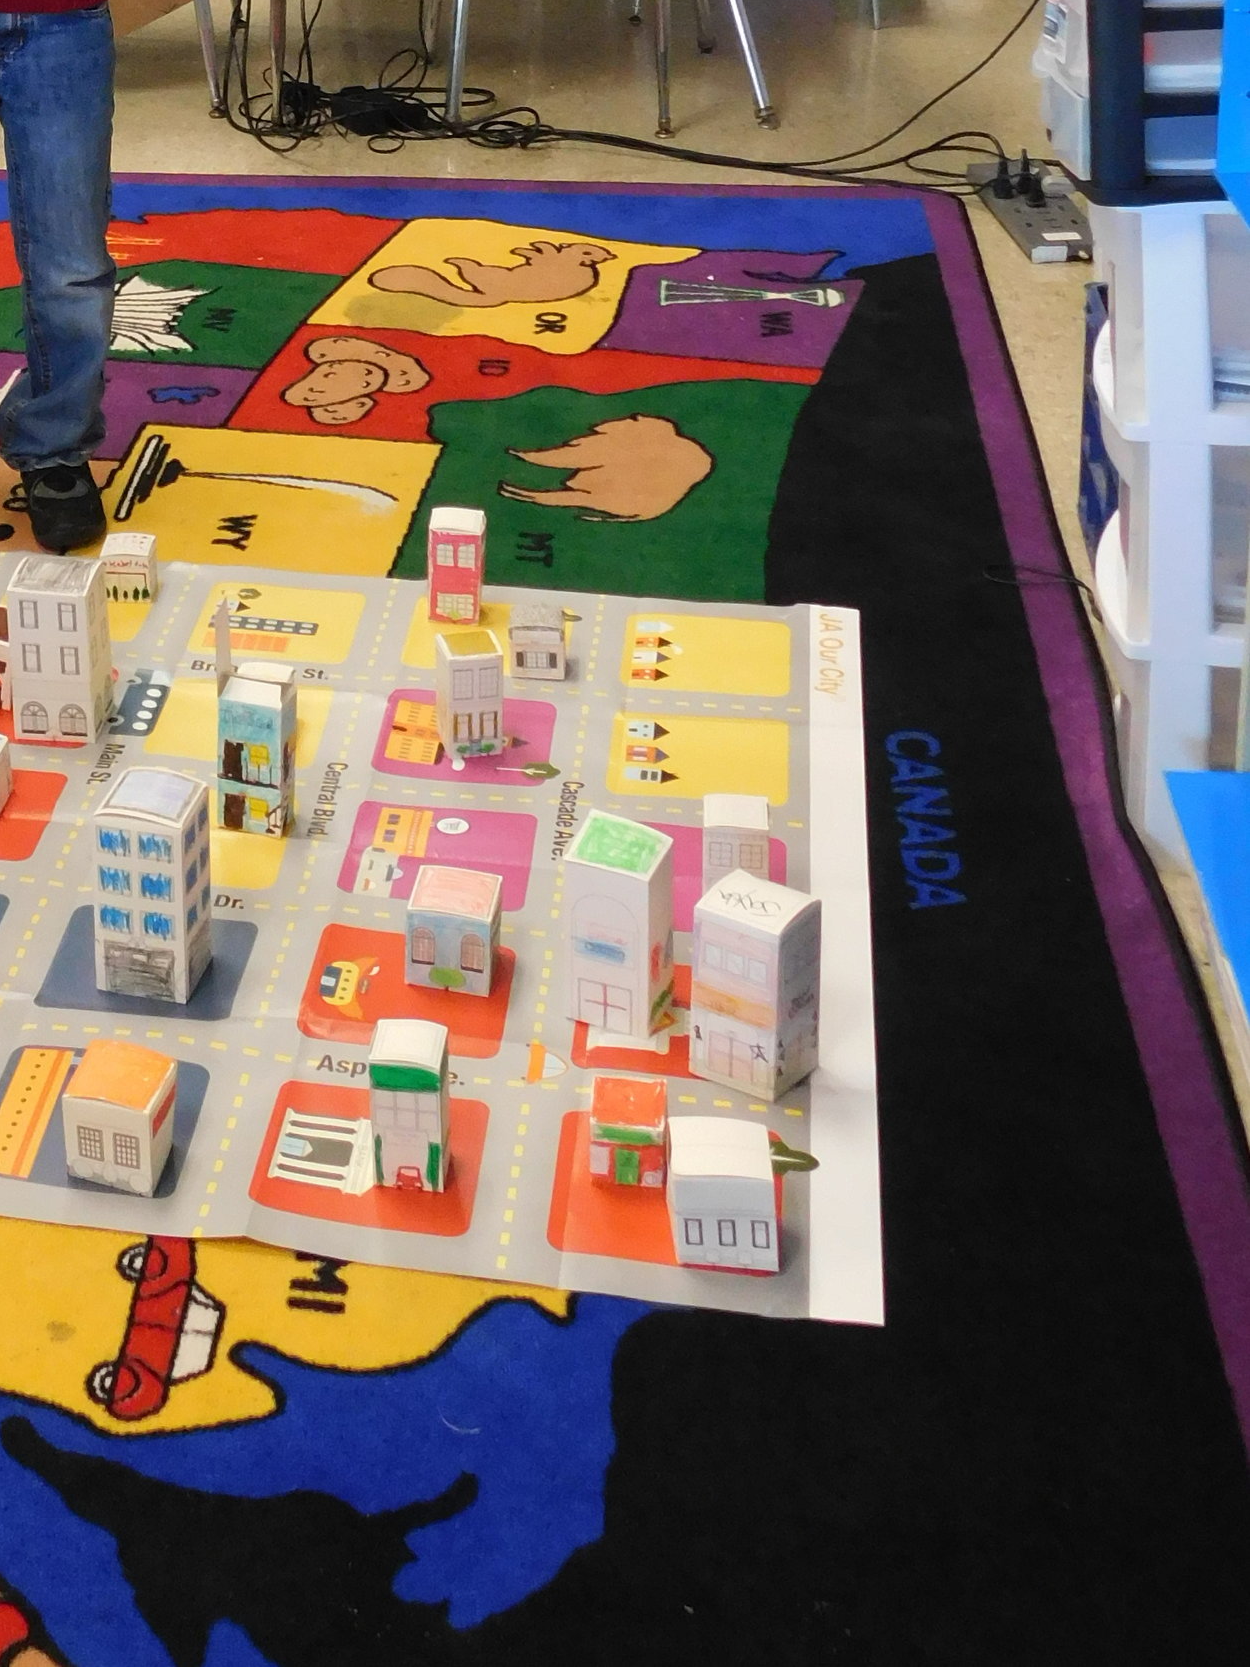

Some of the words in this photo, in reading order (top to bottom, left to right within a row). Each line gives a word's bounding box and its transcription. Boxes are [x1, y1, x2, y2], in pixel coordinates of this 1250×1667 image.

[201, 306, 237, 332] NV
[535, 311, 568, 335] OR
[759, 310, 793, 337] WA
[479, 359, 510, 376] ID
[211, 515, 257, 550] WY
[516, 532, 554, 567] MT
[819, 613, 844, 633] JA
[818, 637, 845, 664] Our
[301, 667, 329, 680] St.
[813, 668, 845, 695] City
[95, 743, 126, 769] Main
[86, 771, 112, 785] St.
[316, 762, 349, 806] Central
[555, 781, 585, 828] Cascade
[306, 808, 336, 837] Blvd.
[885, 731, 967, 910] CANADA
[551, 830, 575, 861] Ave.
[213, 894, 244, 910] Dr.
[316, 1054, 367, 1078] Asp
[286, 1252, 349, 1314] MI
